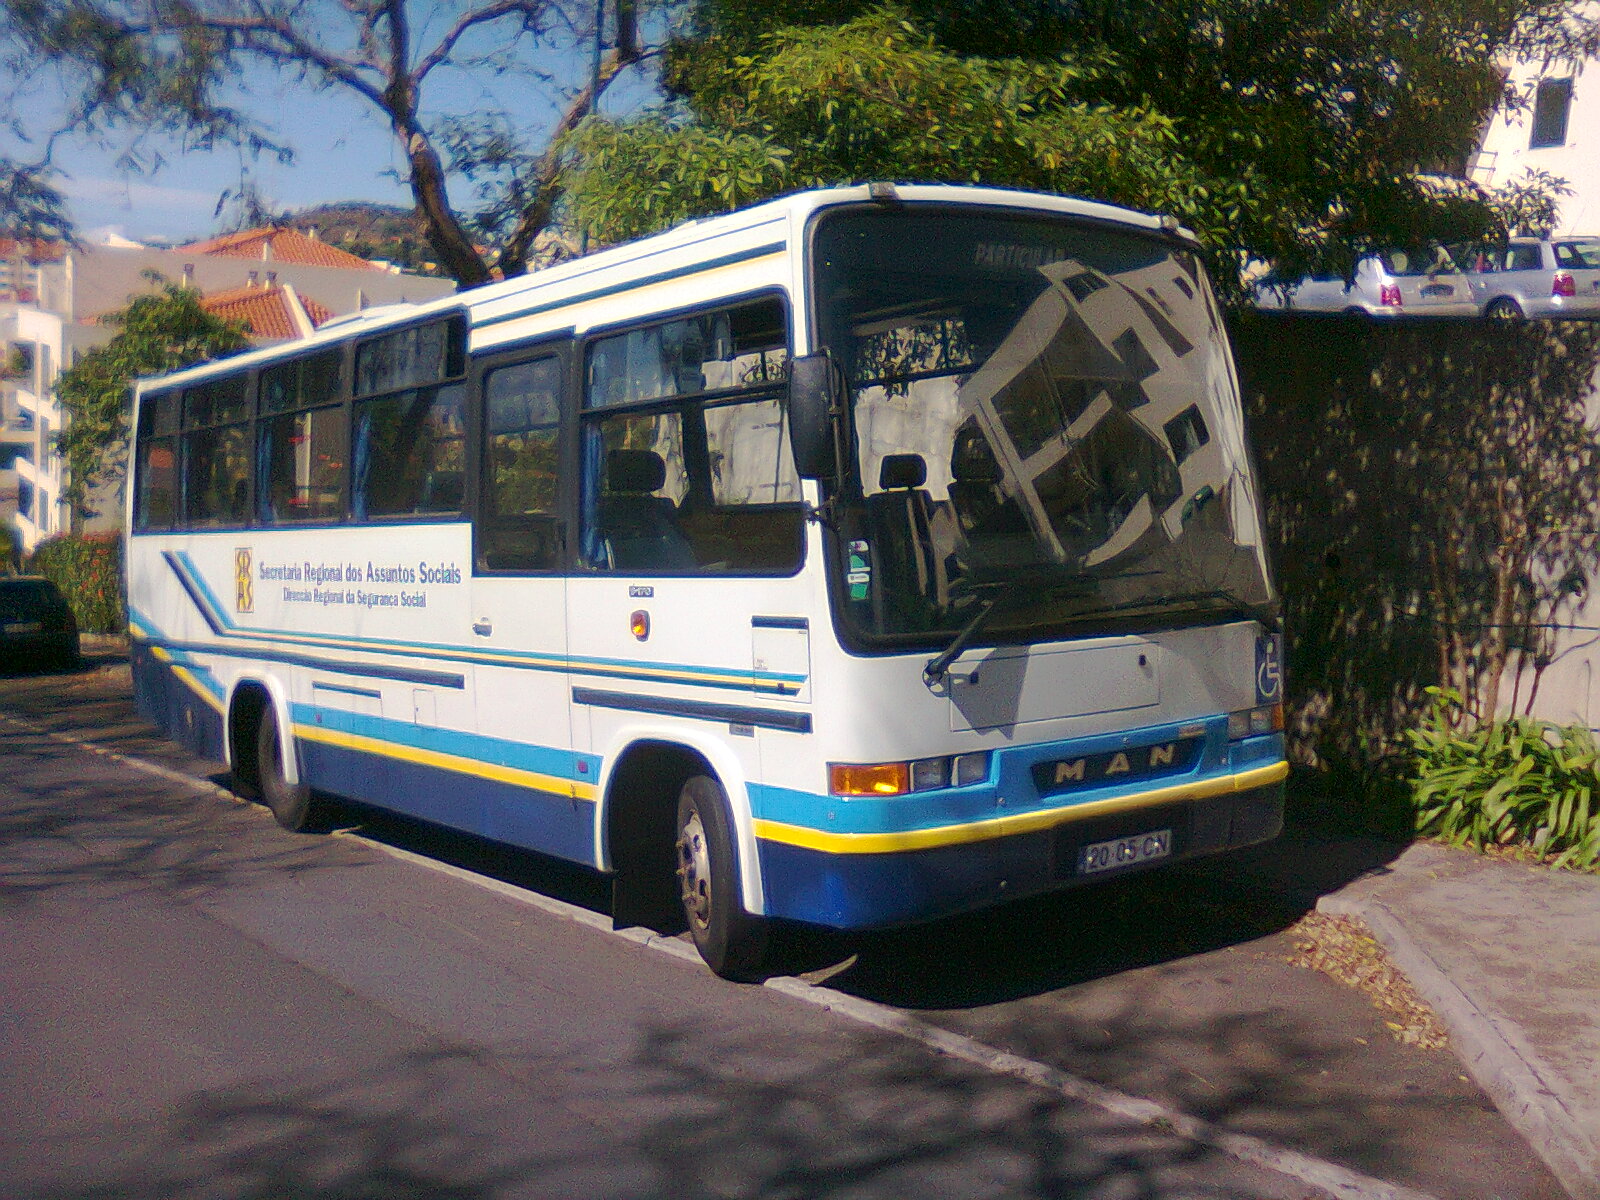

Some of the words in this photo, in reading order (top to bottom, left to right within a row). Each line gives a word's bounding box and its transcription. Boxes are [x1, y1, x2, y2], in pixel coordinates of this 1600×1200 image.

[259, 561, 302, 581] Secretaria
[304, 561, 343, 586] Regional
[345, 563, 363, 582] dos
[366, 561, 416, 584] Assuntos
[419, 561, 462, 584] Sociais
[346, 589, 355, 604] da
[1055, 743, 1176, 784] MAN
